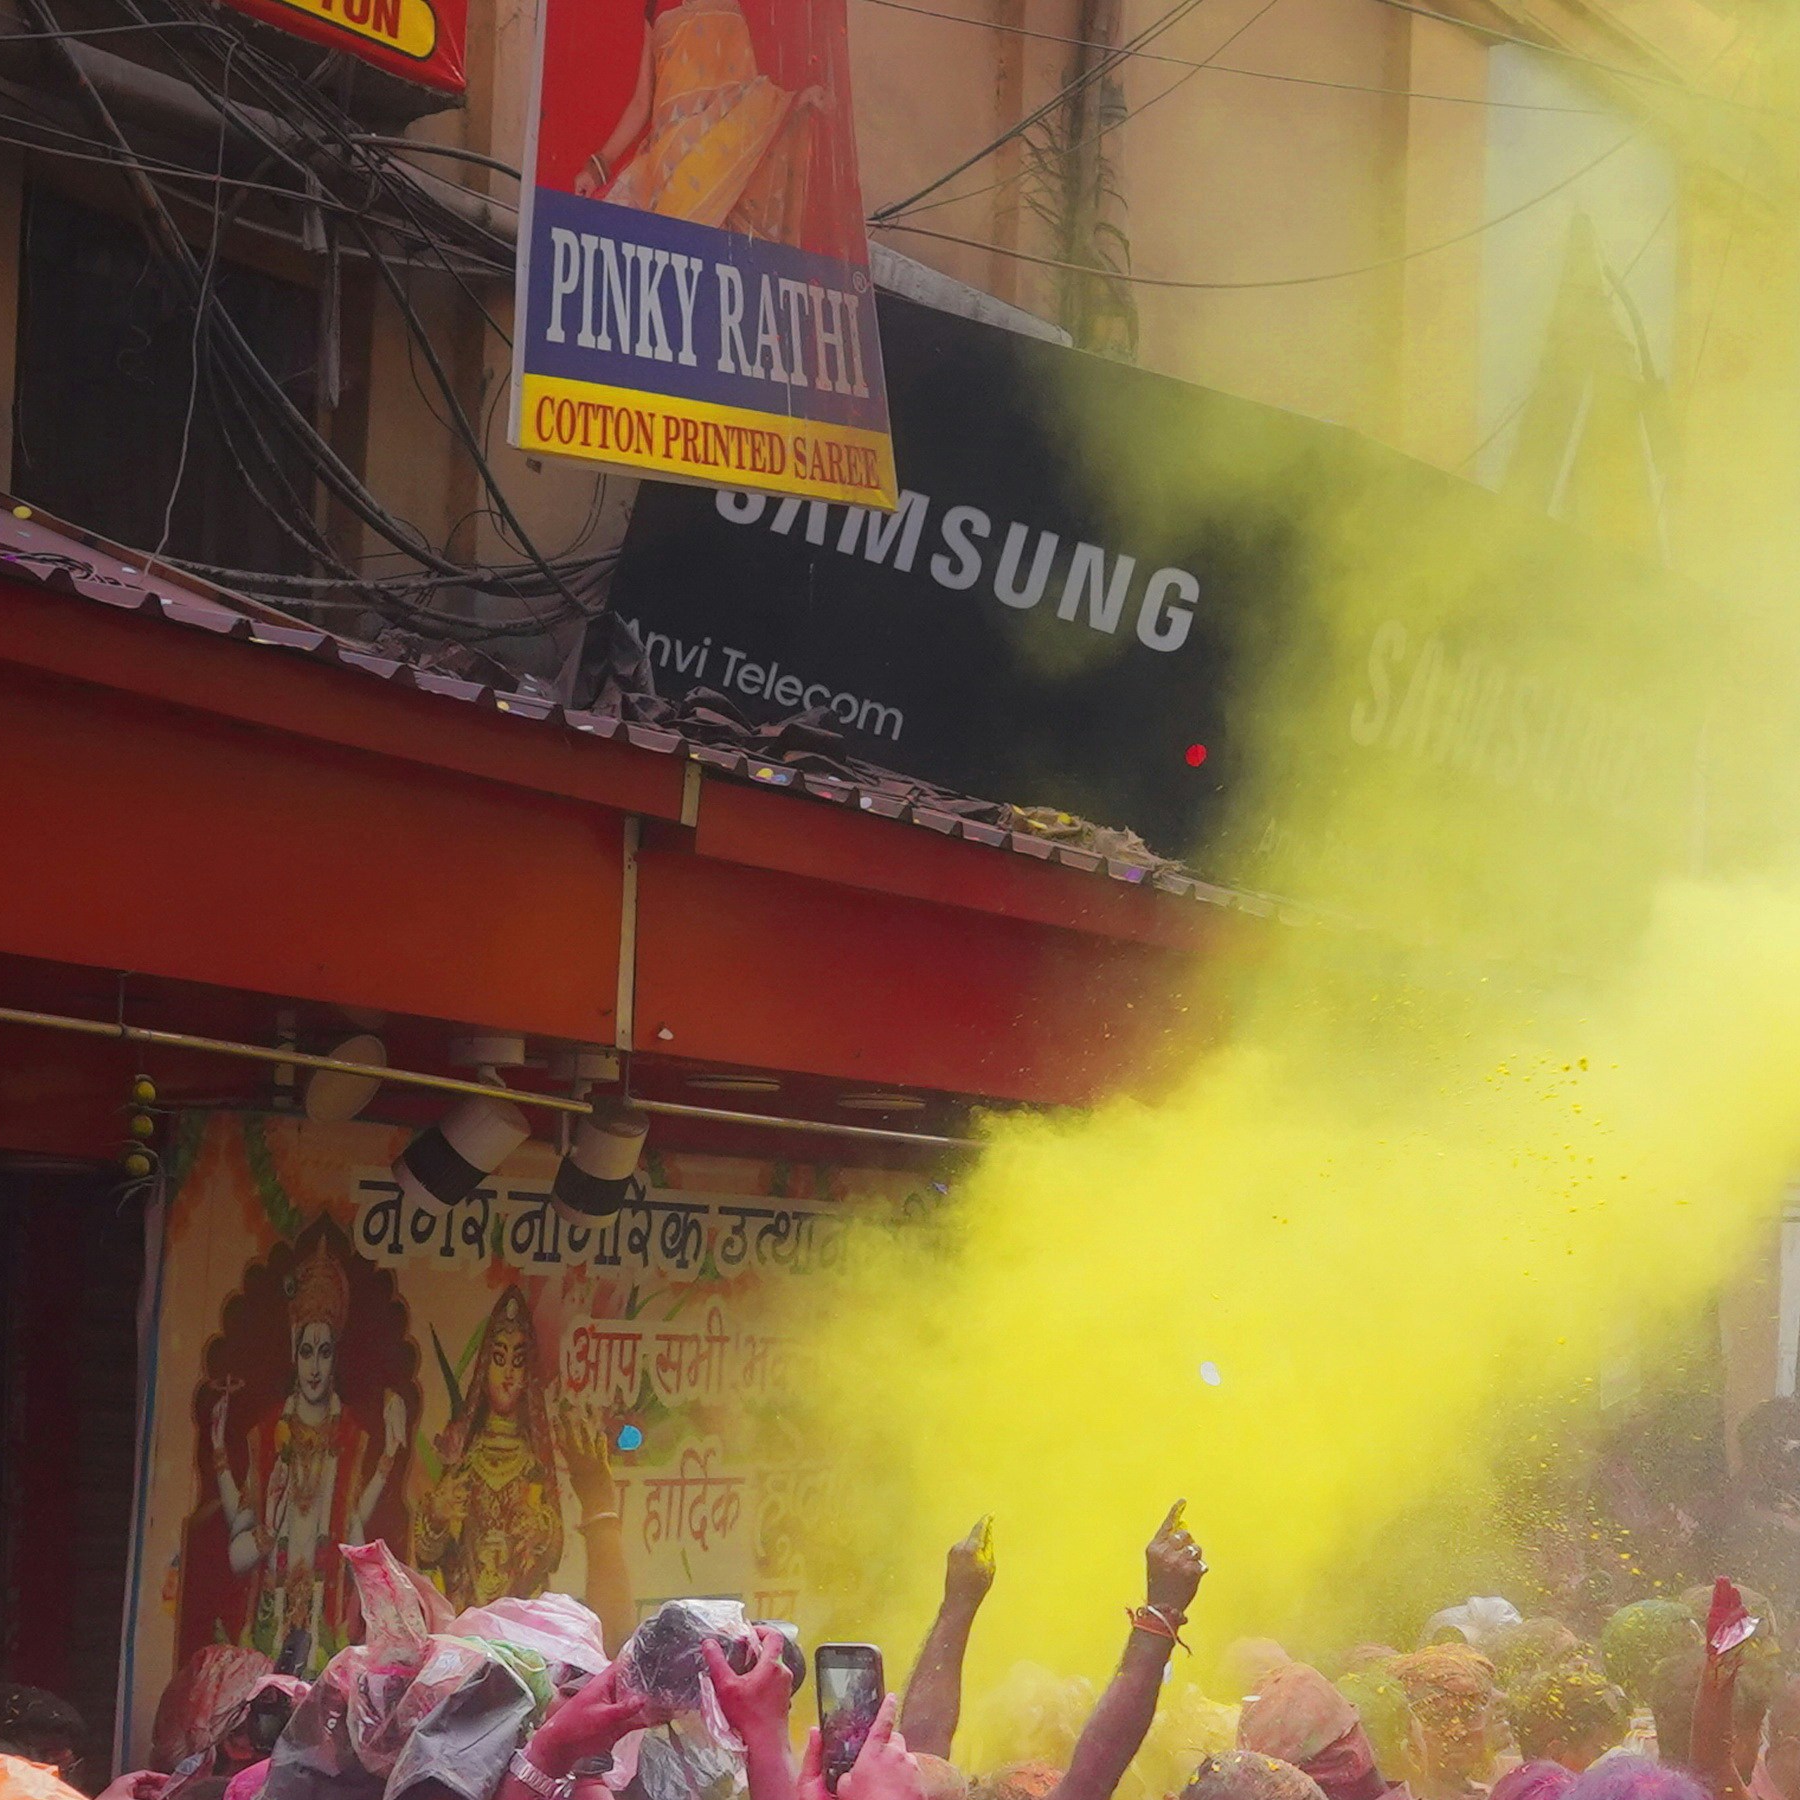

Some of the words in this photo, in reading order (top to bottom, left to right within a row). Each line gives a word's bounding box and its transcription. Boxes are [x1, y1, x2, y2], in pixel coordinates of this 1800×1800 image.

[546, 226, 703, 368] PINKY
[715, 262, 871, 400] RATHI
[535, 396, 656, 457] COTTON
[662, 416, 787, 476] PRINTED
[793, 436, 881, 490] SAREE
[721, 646, 904, 741] Telecom
[567, 1326, 643, 1394] आप
[654, 1306, 731, 1395] सभी
[643, 1447, 747, 1554] हार्दिक
